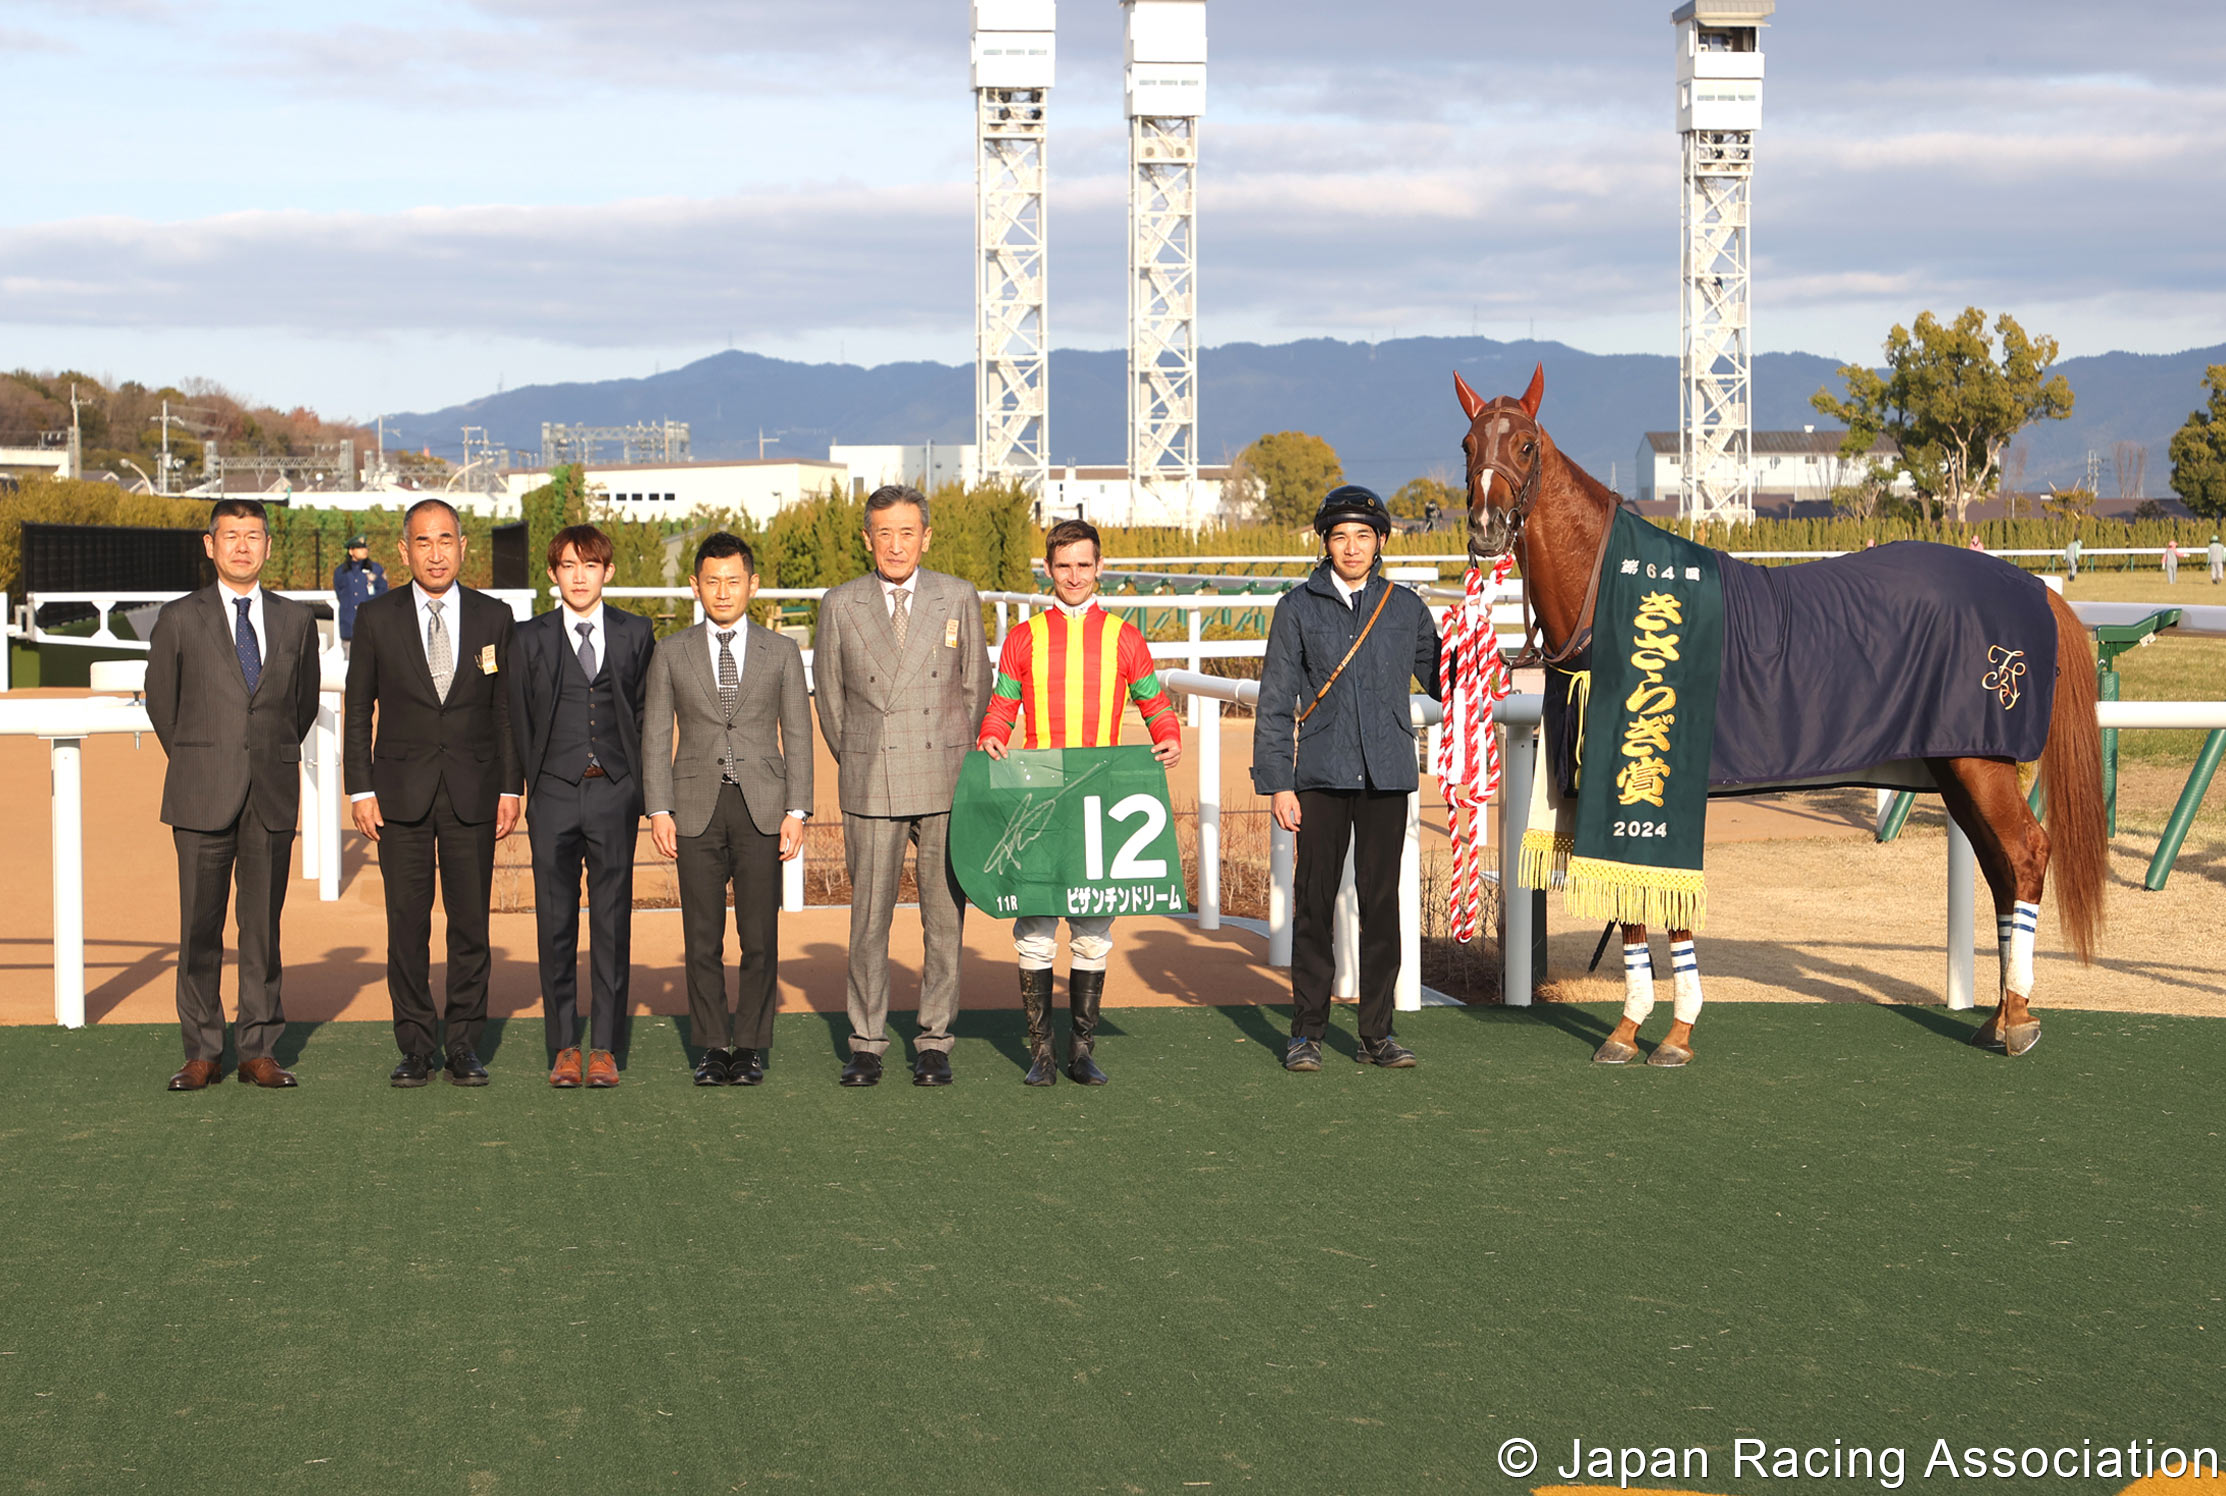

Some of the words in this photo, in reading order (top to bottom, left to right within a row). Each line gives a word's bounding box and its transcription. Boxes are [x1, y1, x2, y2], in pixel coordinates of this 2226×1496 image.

[1616, 590, 1683, 808] きさらぎ賞
[1083, 793, 1168, 881] 12
[1613, 820, 1668, 838] 2024
[996, 894, 1019, 912] 11R
[1066, 884, 1182, 915] ビザンチンドリーム
